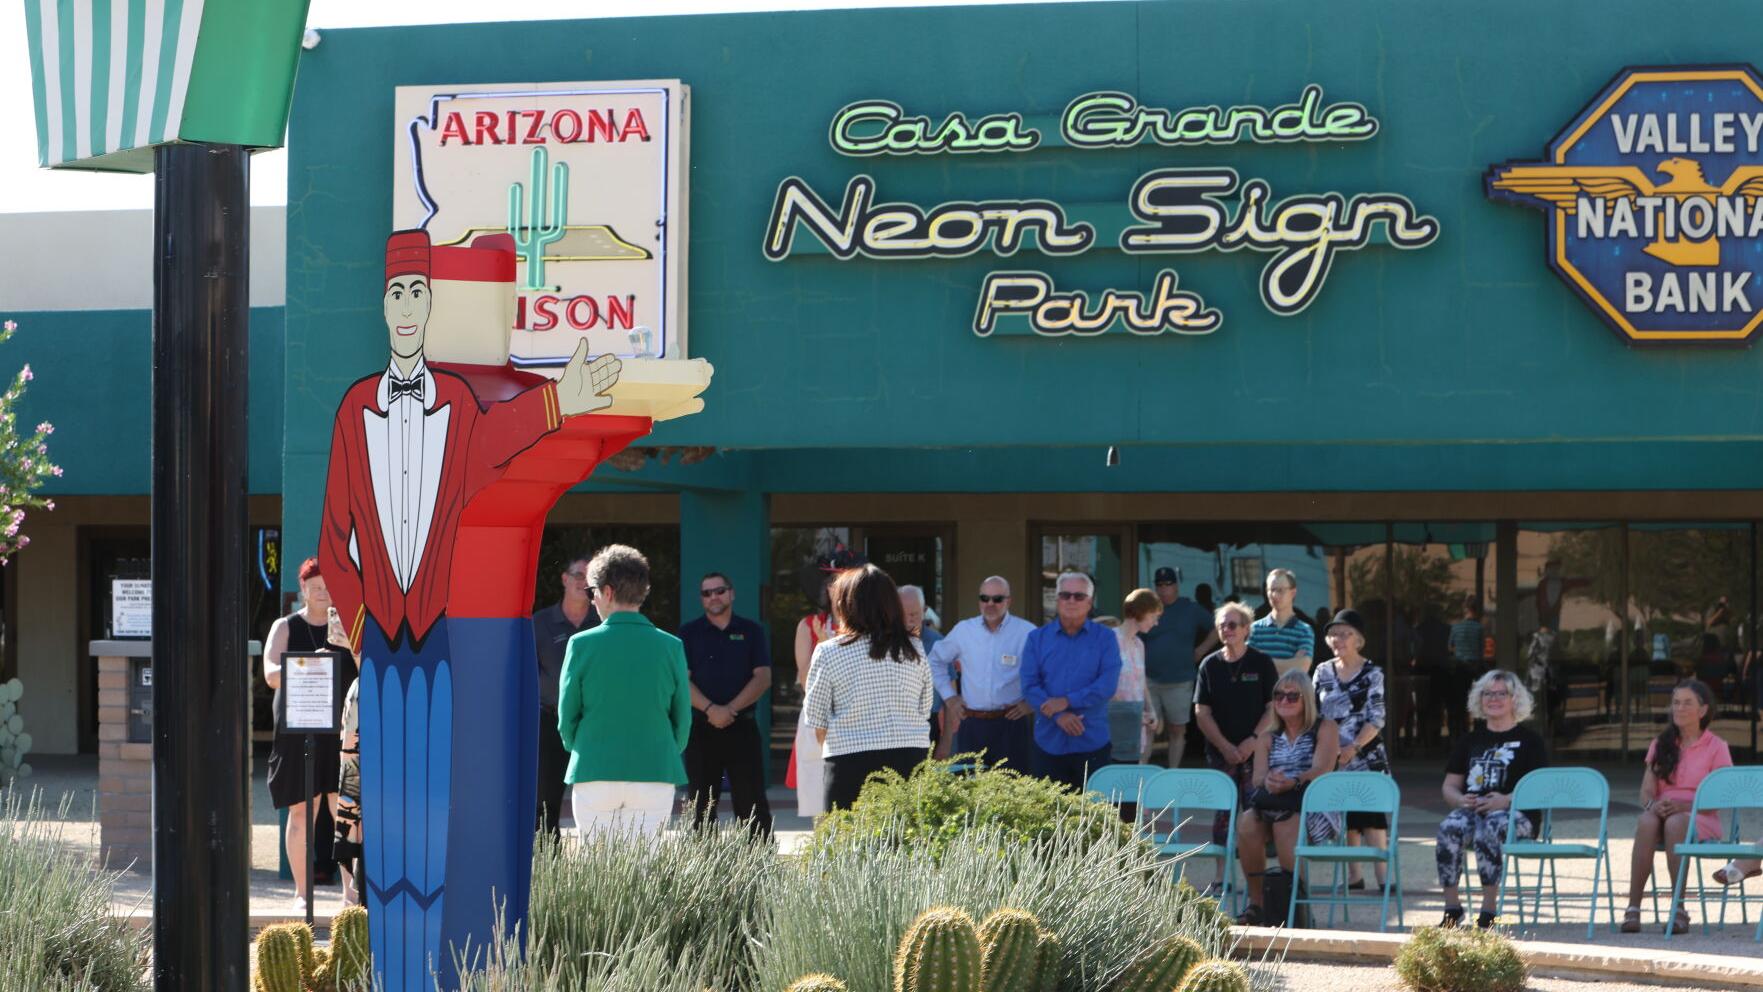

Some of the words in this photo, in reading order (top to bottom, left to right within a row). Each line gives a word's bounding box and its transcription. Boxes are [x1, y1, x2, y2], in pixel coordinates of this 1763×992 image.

[438, 108, 651, 145] ARIZONA
[832, 102, 1039, 155] Casa
[1063, 86, 1377, 147] Grande
[1611, 113, 1763, 153] VALLEY
[1577, 196, 1763, 238] NATIONA
[766, 176, 1093, 259] Neon
[1122, 168, 1438, 313] Sign
[513, 294, 636, 332] ISON
[975, 272, 1221, 334] Park
[1625, 272, 1752, 313] BANK
[885, 552, 915, 563] SUITE
[918, 553, 927, 563] K
